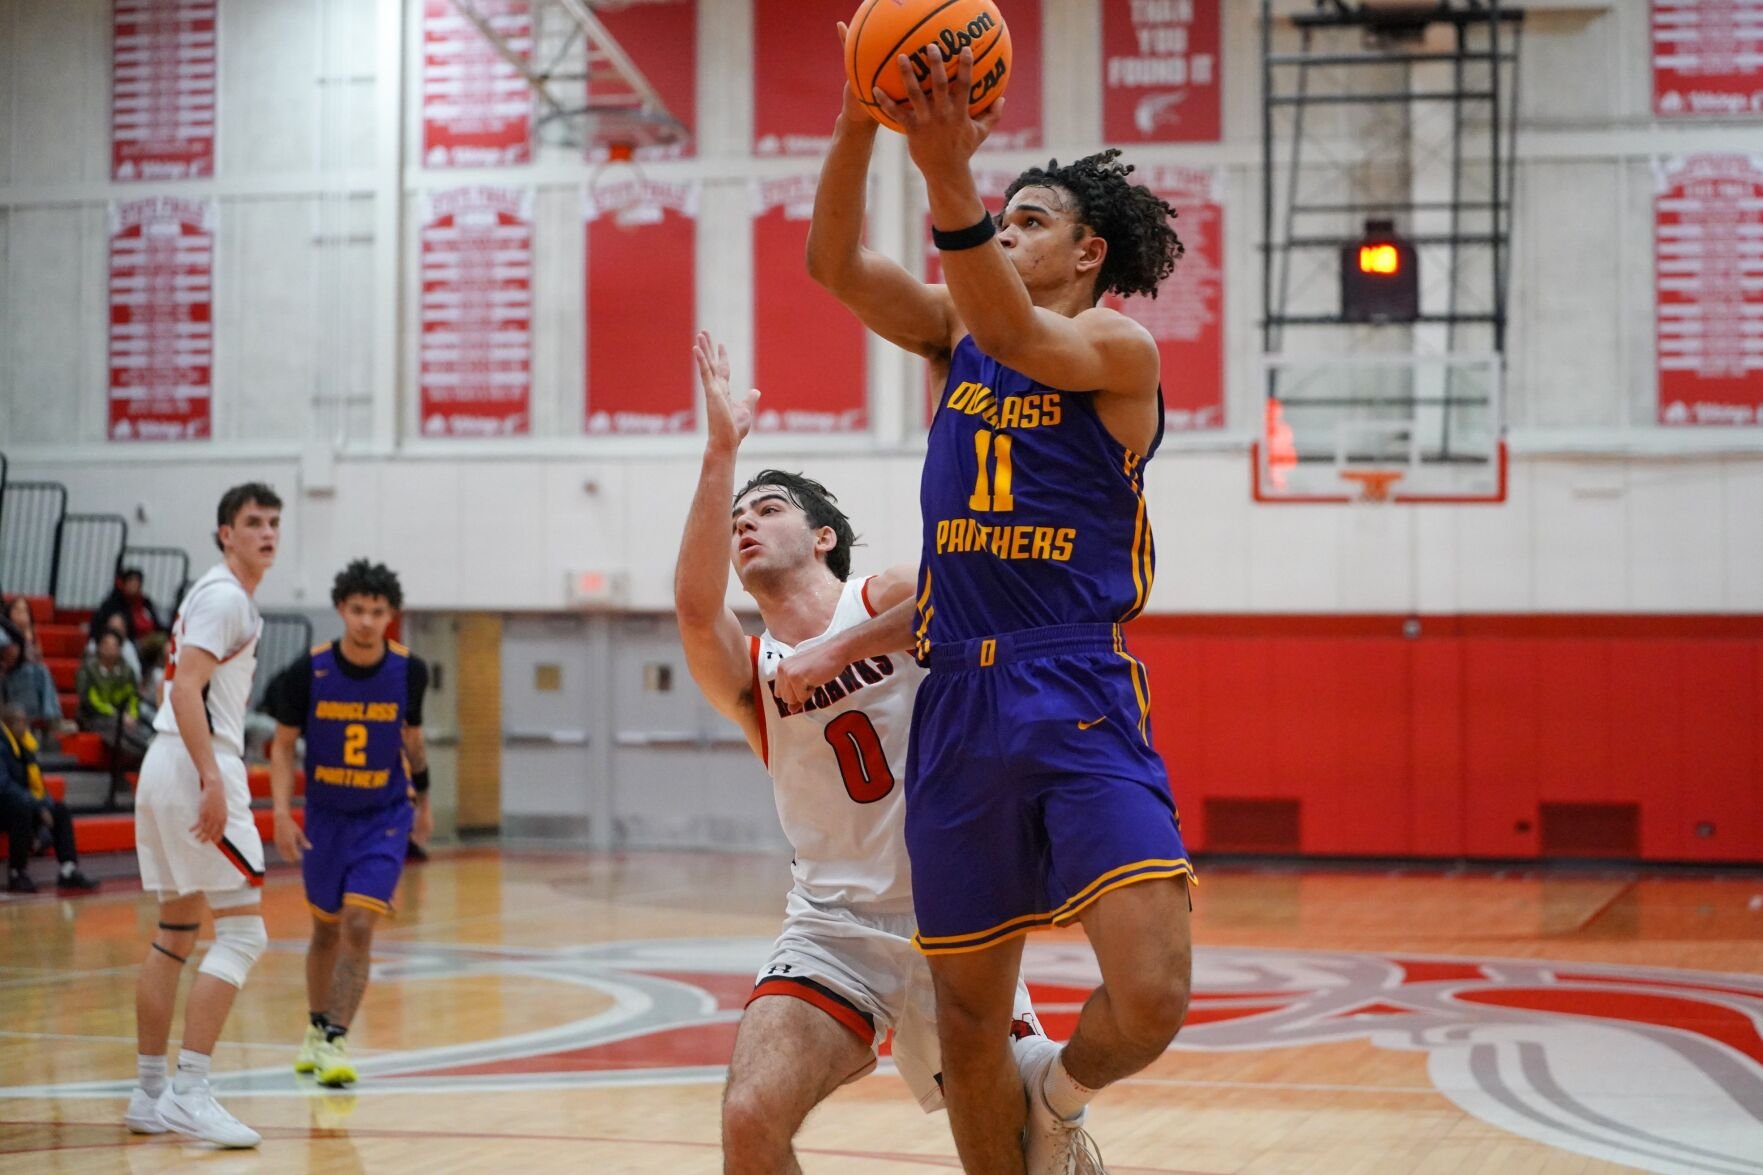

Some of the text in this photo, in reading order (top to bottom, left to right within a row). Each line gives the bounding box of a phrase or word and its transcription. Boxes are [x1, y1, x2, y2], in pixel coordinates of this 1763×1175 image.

[969, 57, 1006, 104] CAA
[1107, 55, 1187, 88] FOUND
[947, 381, 1063, 430] DUGASS
[969, 428, 1014, 513] 11
[936, 518, 1077, 561] PANTHERS
[767, 654, 894, 719] RHAWKS
[316, 701, 398, 721] DOUGLASS
[344, 724, 368, 766] 2
[824, 709, 895, 805] 0
